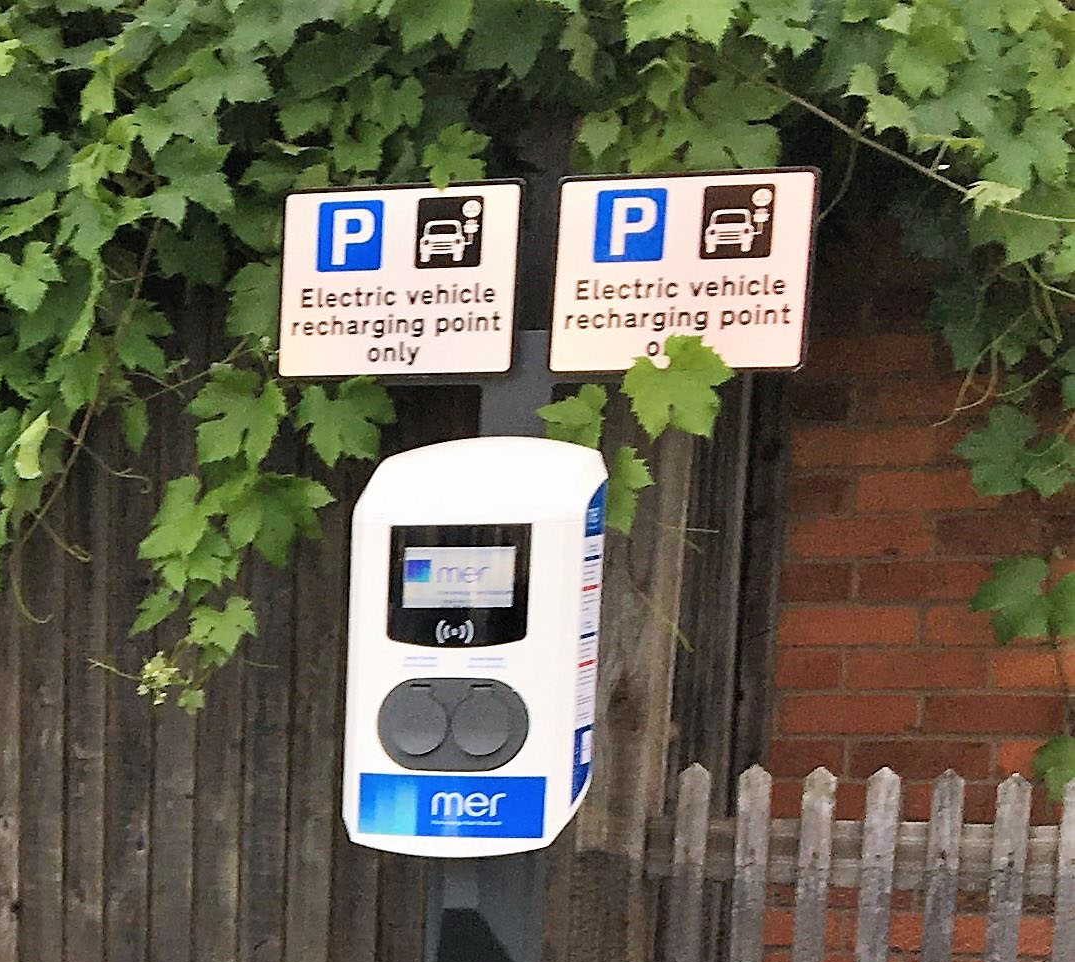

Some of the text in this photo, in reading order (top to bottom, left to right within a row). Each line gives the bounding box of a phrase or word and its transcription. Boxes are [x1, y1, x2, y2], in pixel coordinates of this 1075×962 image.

[331, 208, 375, 266] P
[609, 196, 658, 256] P
[300, 282, 496, 309] Electric vehicle
[575, 274, 786, 301] Electric vehicle
[290, 311, 503, 339] recharging point
[564, 303, 792, 332] recharging point
[366, 341, 421, 366] only
[436, 566, 491, 584] mer
[430, 791, 507, 818] mer
